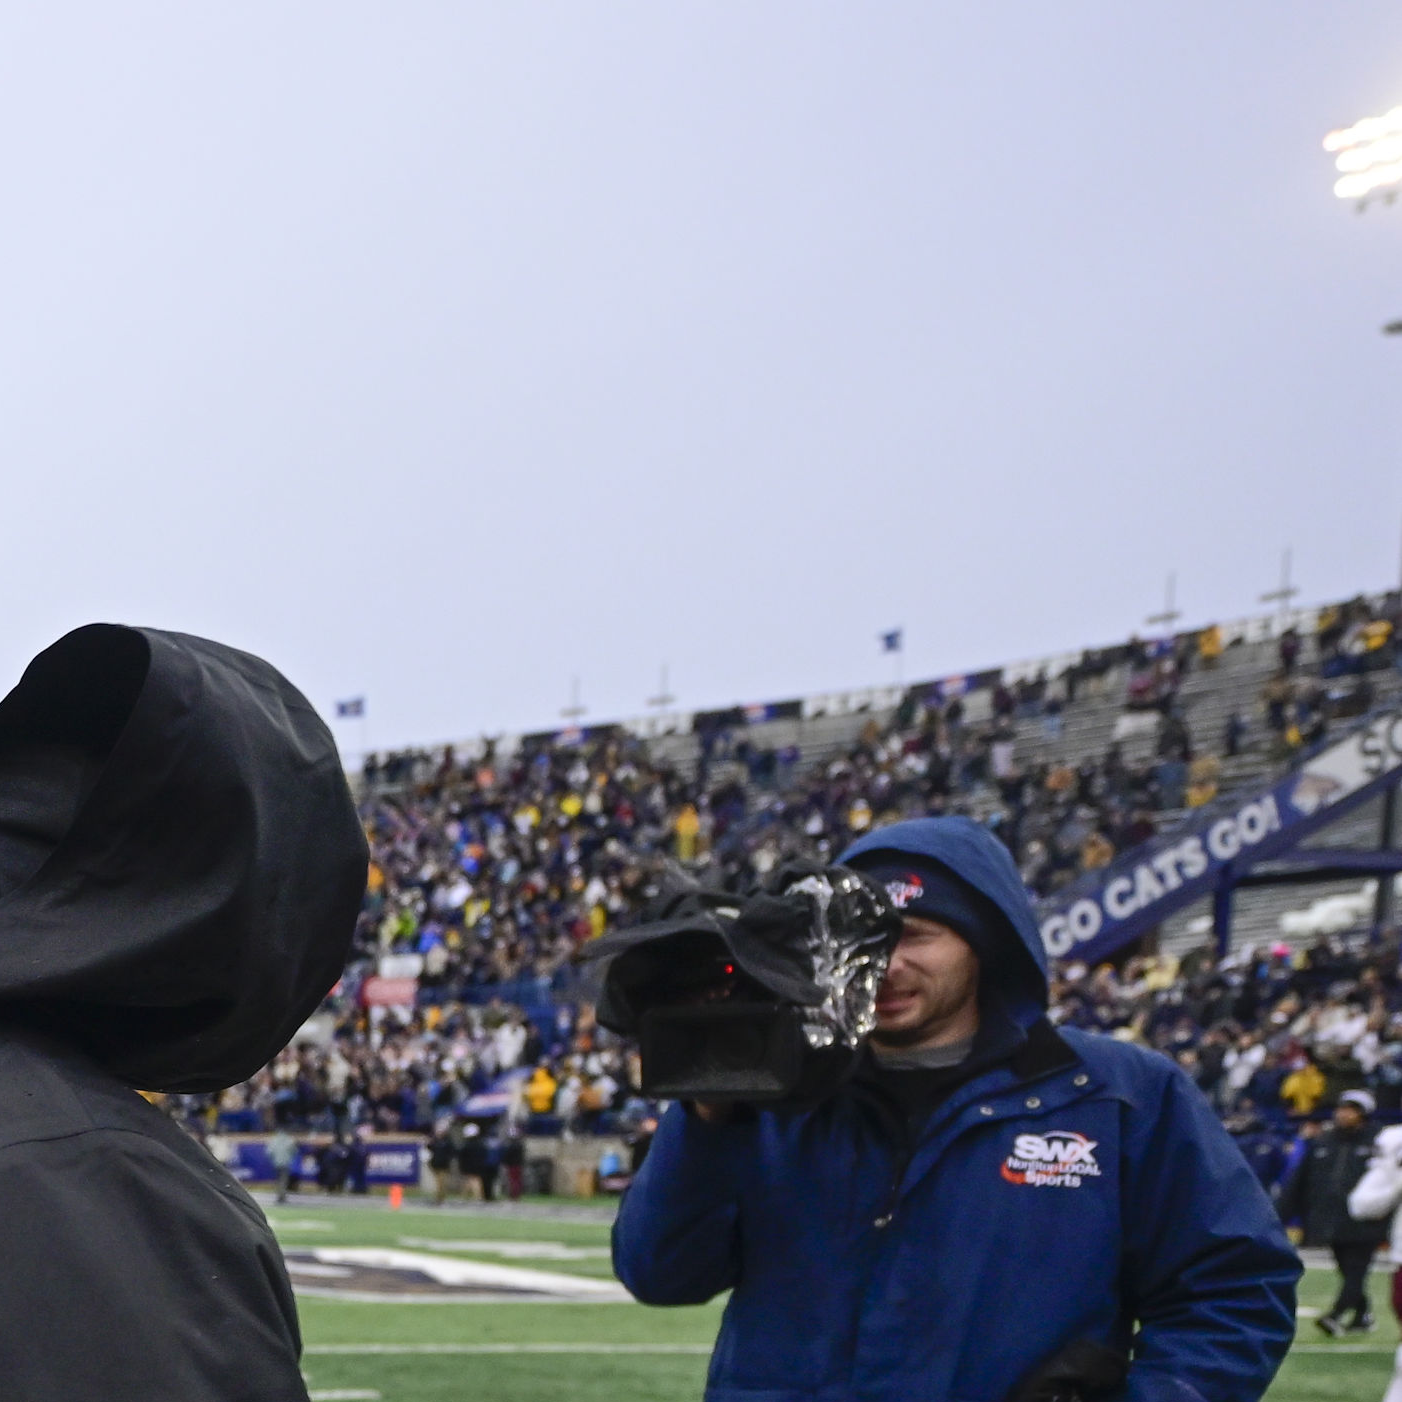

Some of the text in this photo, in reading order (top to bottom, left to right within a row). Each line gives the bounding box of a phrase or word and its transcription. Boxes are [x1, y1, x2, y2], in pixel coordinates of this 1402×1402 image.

[1040, 795, 1283, 957] GO CATS GO!
[1014, 1133, 1098, 1164] SWX
[1025, 1170, 1082, 1188] Sports
